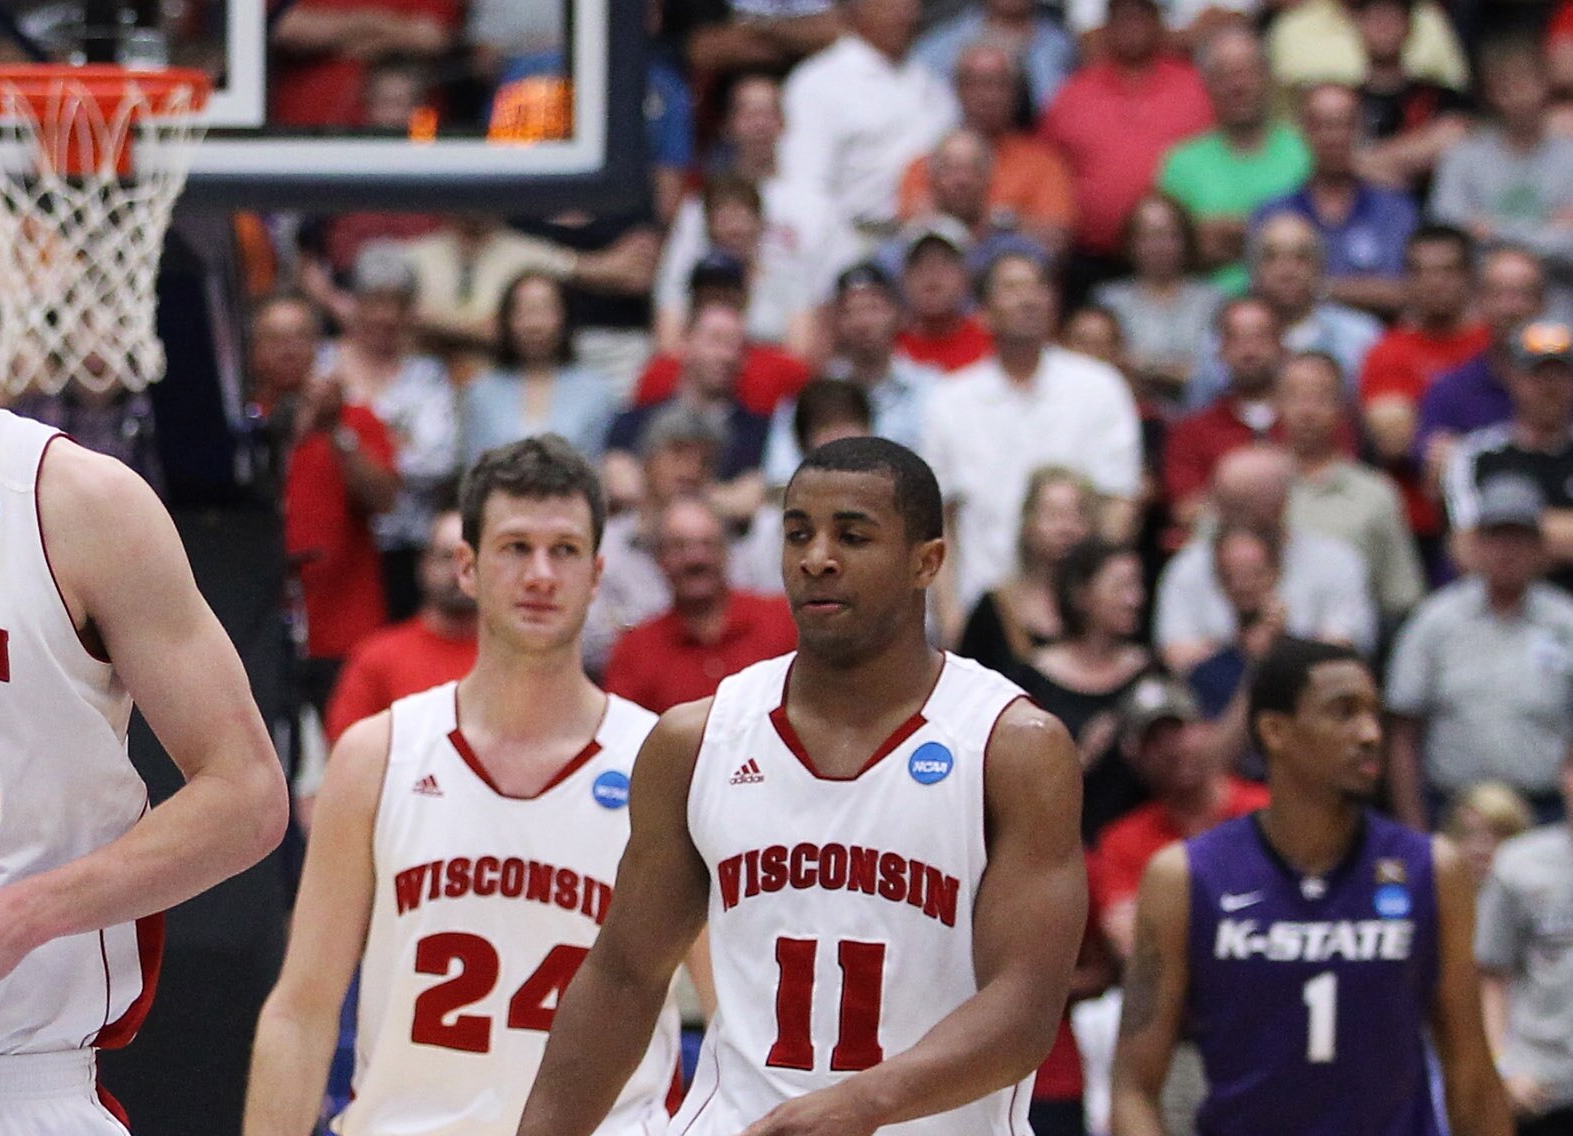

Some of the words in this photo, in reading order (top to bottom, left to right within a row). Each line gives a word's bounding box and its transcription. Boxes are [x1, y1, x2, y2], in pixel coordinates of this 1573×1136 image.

[718, 842, 961, 928] WISCONSIN
[1214, 918, 1416, 962] K-STATE
[411, 931, 591, 1054] 24
[765, 936, 885, 1072] 11
[1302, 970, 1338, 1064] 1
